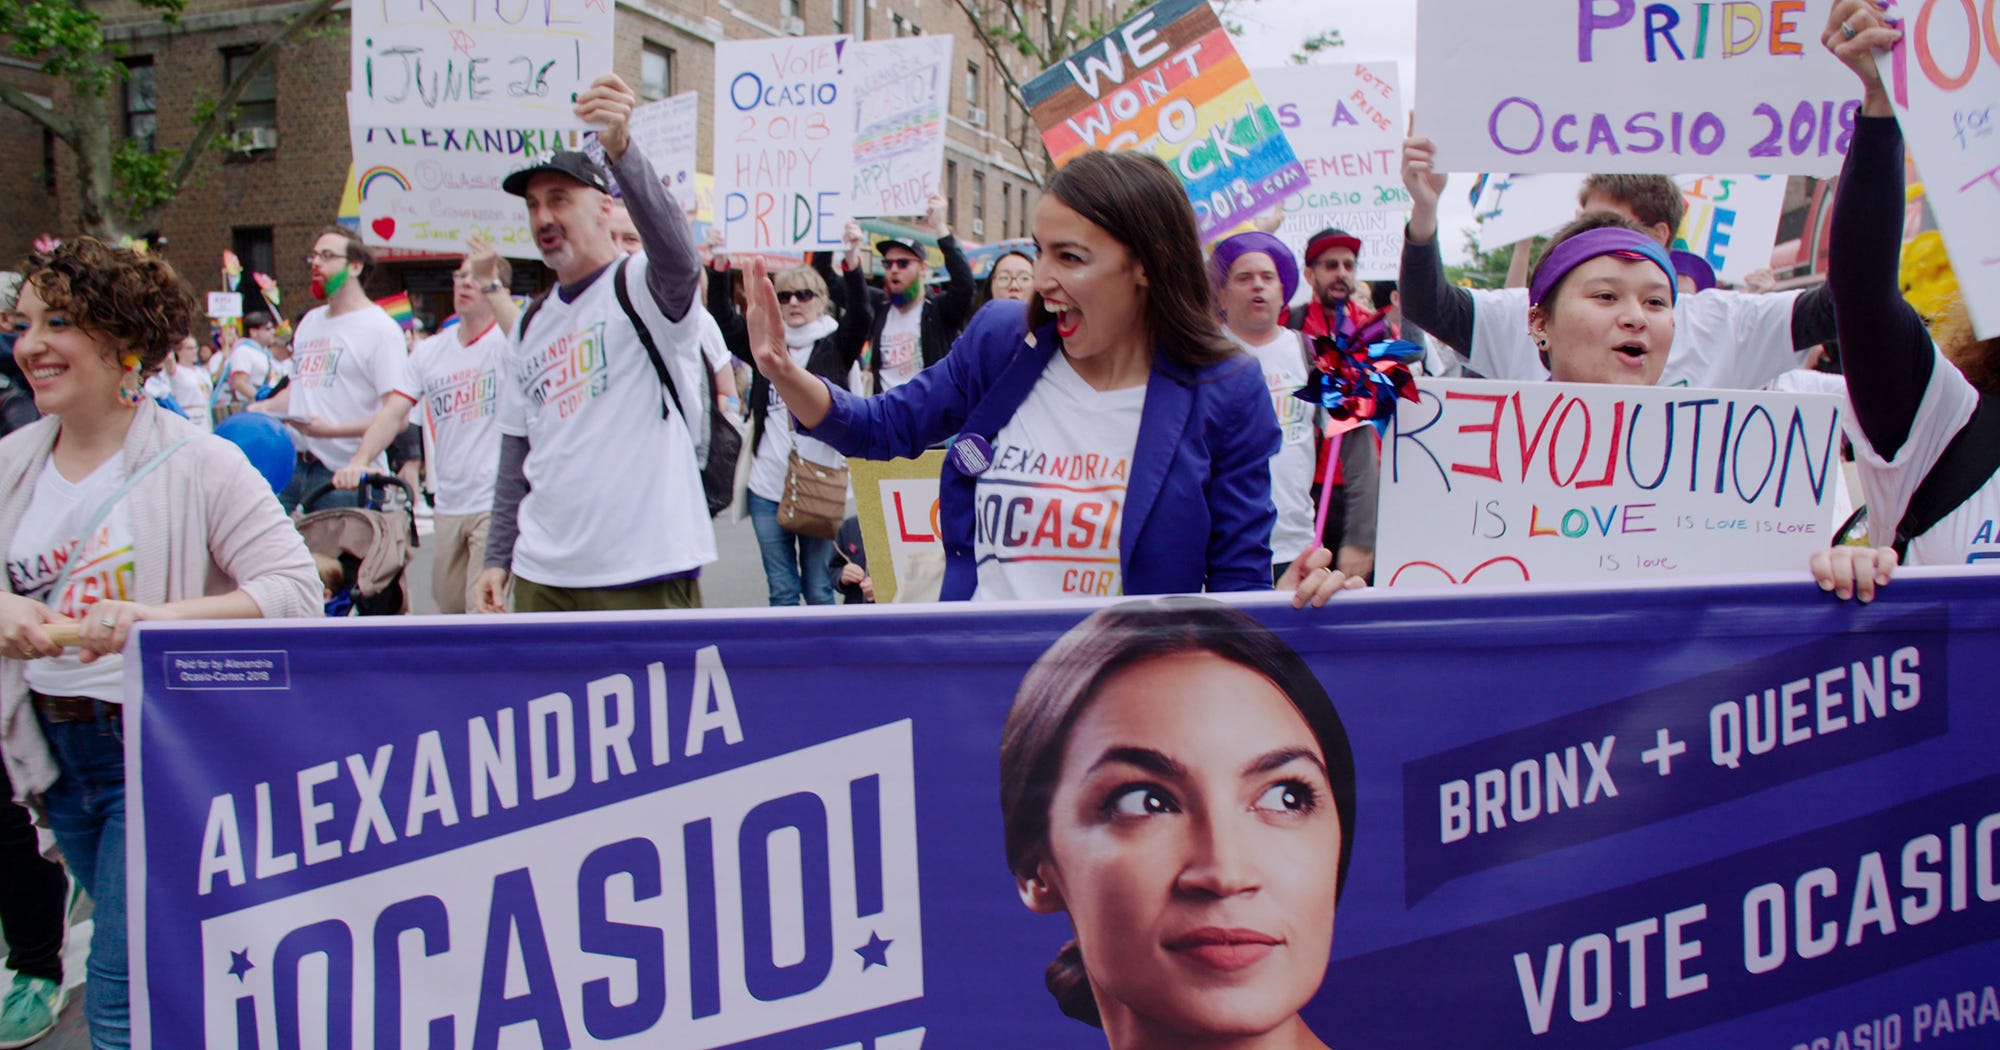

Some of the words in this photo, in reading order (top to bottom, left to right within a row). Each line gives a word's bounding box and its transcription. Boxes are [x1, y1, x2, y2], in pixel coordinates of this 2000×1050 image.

[1065, 11, 1170, 99] WE
[1577, 0, 1805, 62] PRIDE
[1066, 43, 1203, 147] WON'T
[1353, 63, 1393, 99] VOTE
[1331, 100, 1358, 127] A
[1350, 89, 1391, 131] PRIDE
[735, 148, 822, 188] HAPPY
[1306, 149, 1395, 178] EMENT
[725, 191, 842, 249] PRIDE
[880, 171, 934, 213] PRIDE
[1284, 211, 1386, 233] HUMAN
[1393, 389, 1838, 507] REVOLUTION
[1471, 500, 1506, 539] IS
[1529, 503, 1657, 538] LOVE
[1705, 517, 1748, 530] LOVE
[1777, 522, 1817, 534] LOVE
[198, 644, 743, 896] ALEXANDRIA
[1438, 735, 1619, 844] BRONX
[1641, 728, 1686, 776] +
[1709, 646, 1921, 769] QUEENS
[1513, 903, 1708, 1035] VOTE
[1743, 811, 2000, 975] OCASIO
[1913, 986, 2000, 1042] PARA
